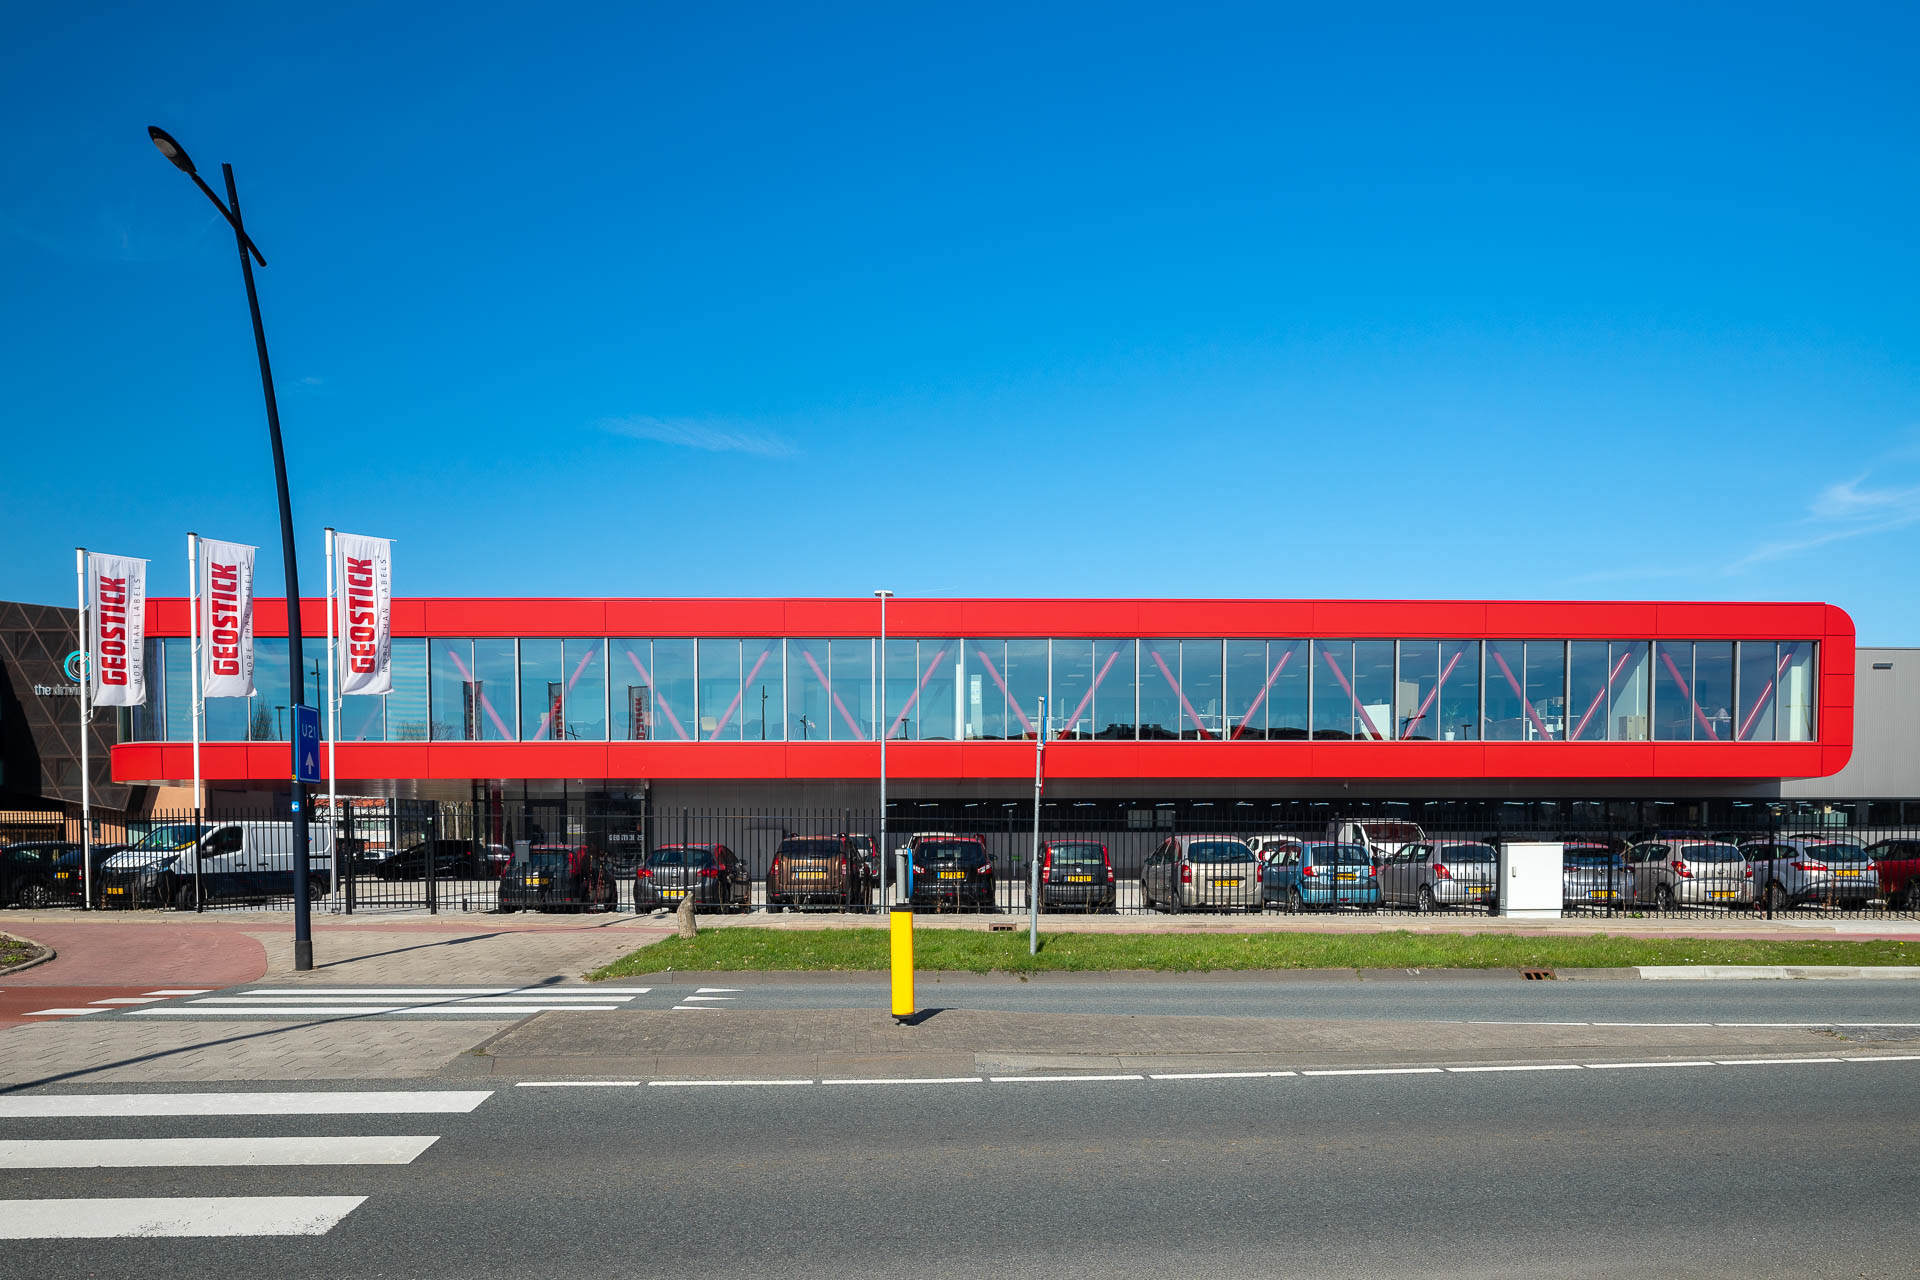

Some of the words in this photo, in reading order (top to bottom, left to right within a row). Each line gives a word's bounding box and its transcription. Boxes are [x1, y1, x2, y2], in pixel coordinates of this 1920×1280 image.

[380, 559, 389, 600] LABELS
[133, 578, 141, 617] LABELS
[100, 575, 127, 686] GEOSTICK
[211, 561, 240, 676] GEOSTICK
[347, 556, 376, 674] GEOSTICK
[132, 624, 140, 651] THAN
[133, 658, 141, 685] MORE
[245, 647, 253, 676] MORE
[34, 683, 51, 696] the
[301, 723, 317, 740] U21
